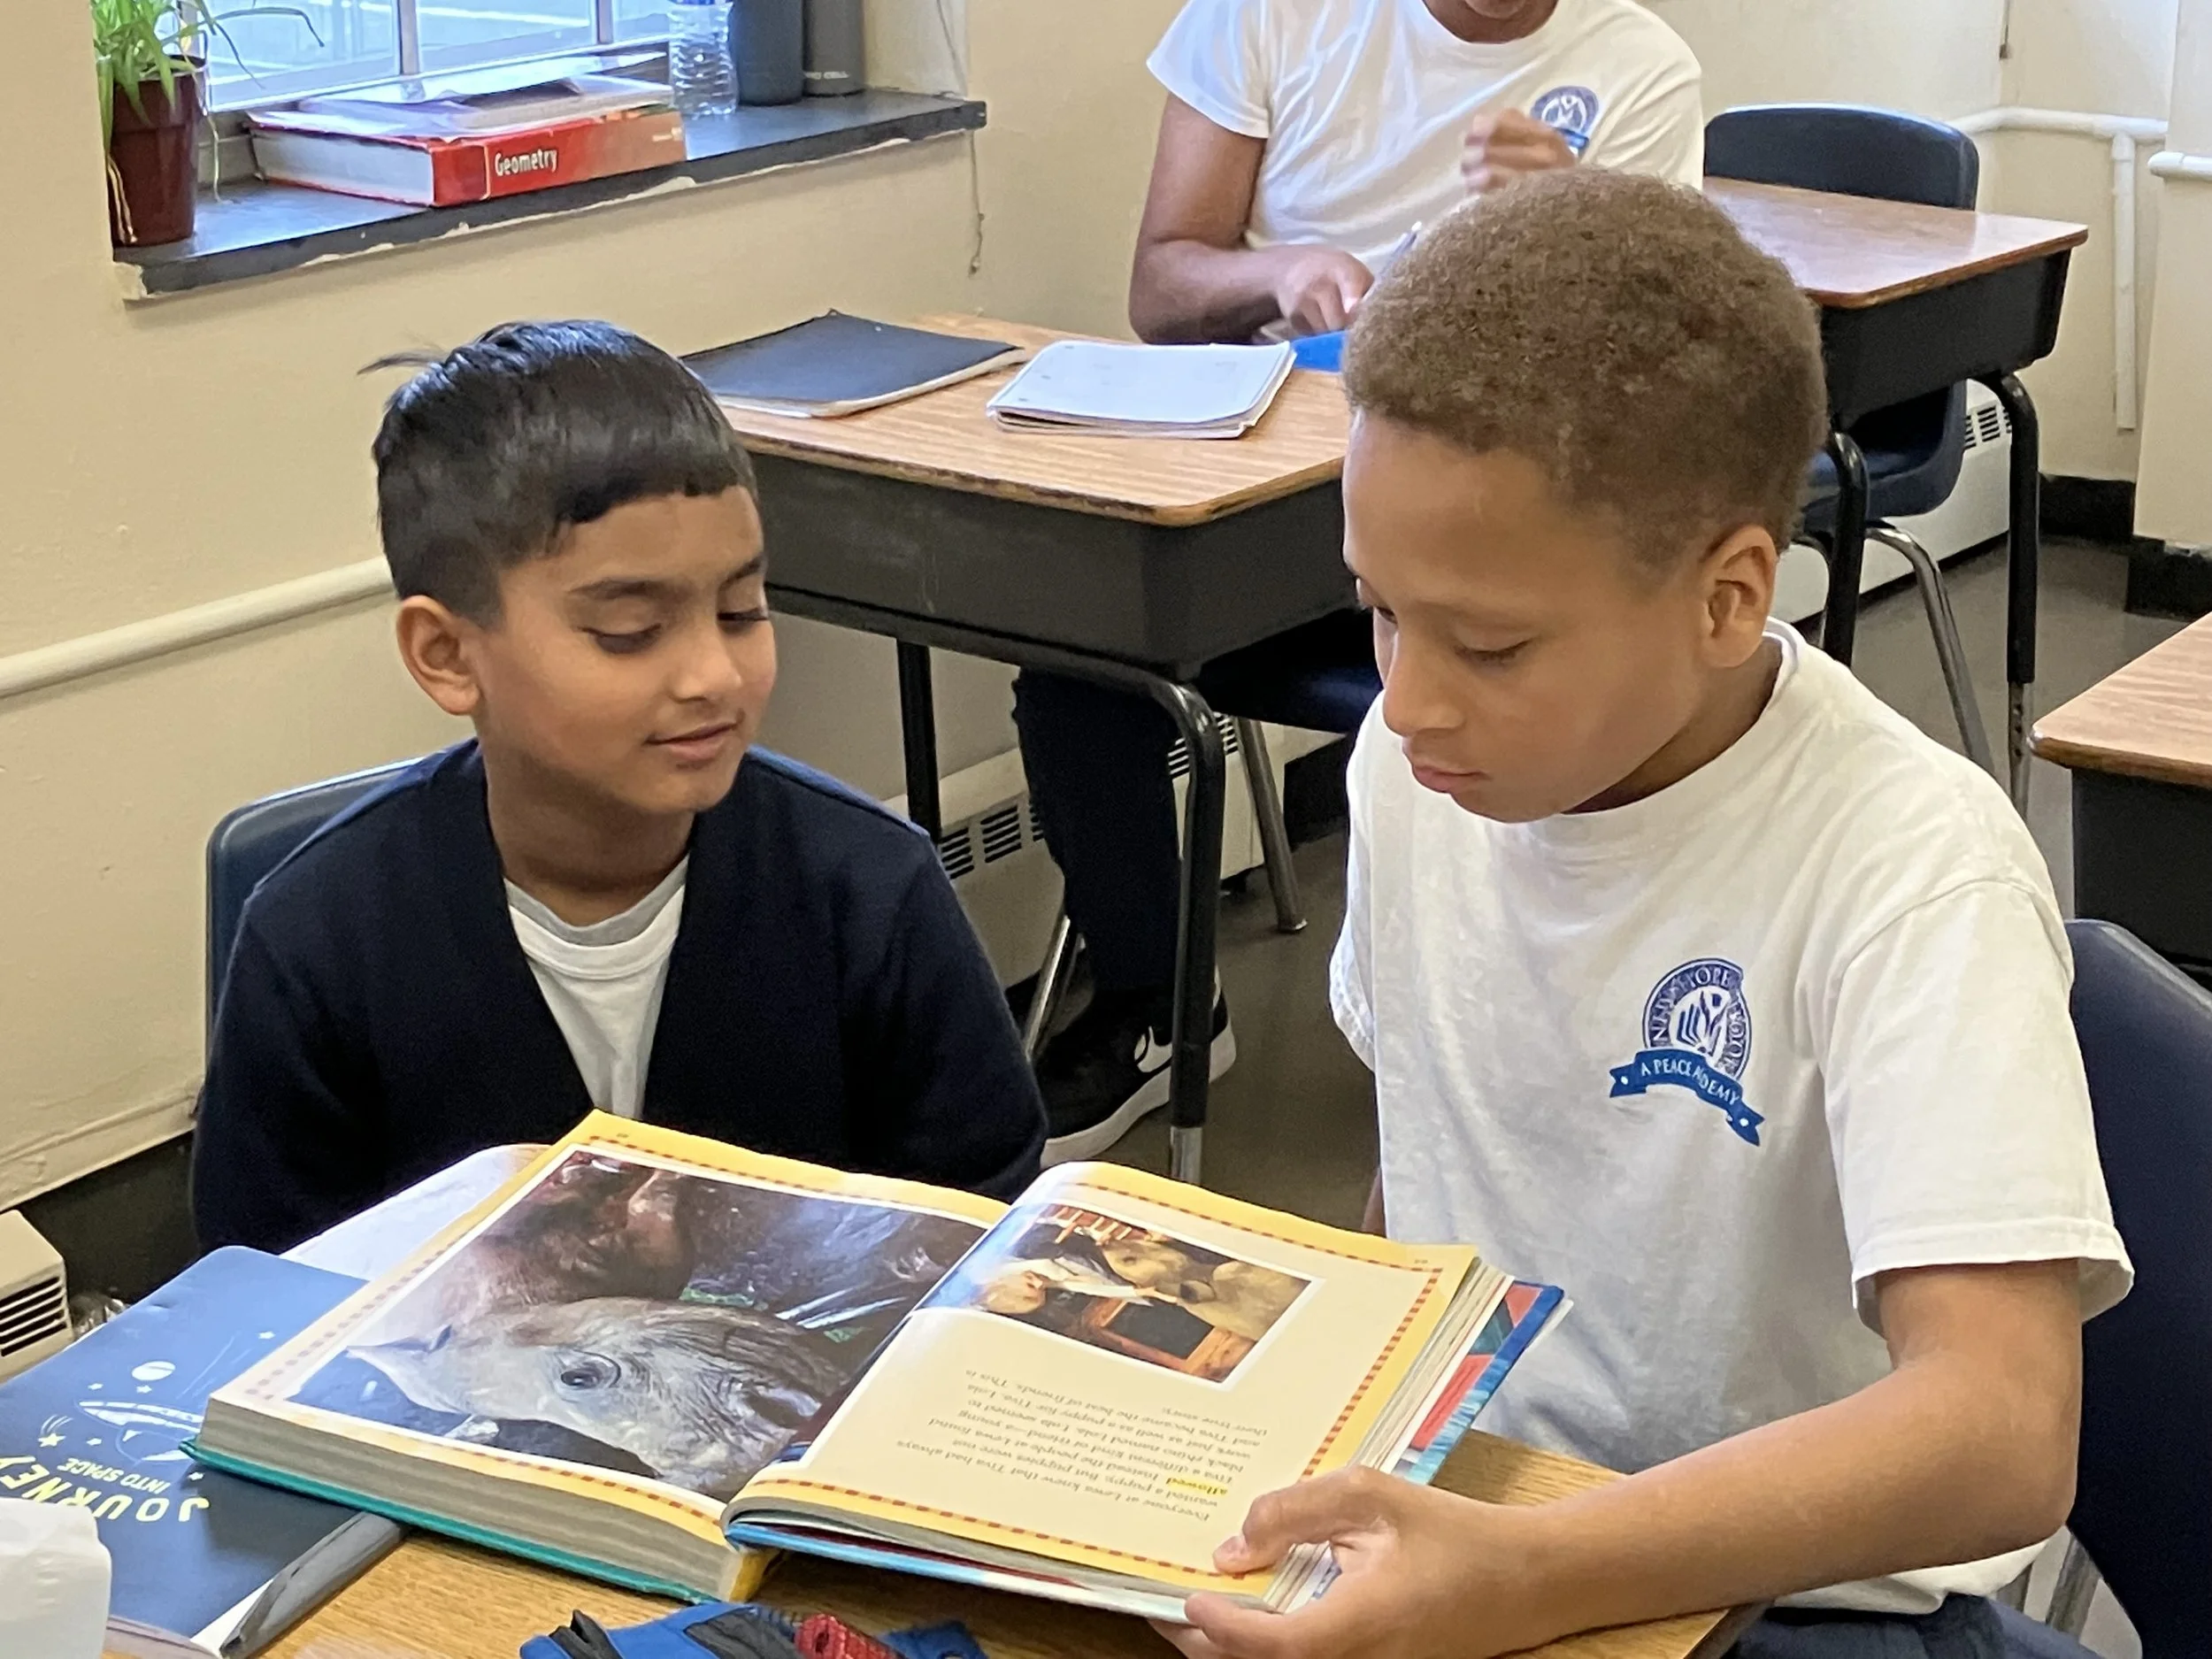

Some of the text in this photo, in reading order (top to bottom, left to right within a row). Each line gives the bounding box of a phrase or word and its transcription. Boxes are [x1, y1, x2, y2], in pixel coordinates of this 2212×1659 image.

[495, 148, 557, 176] Geometry
[1641, 1062, 1652, 1077] A
[1653, 1058, 1692, 1077] PEACE
[57, 1457, 171, 1494] INTO SPACE
